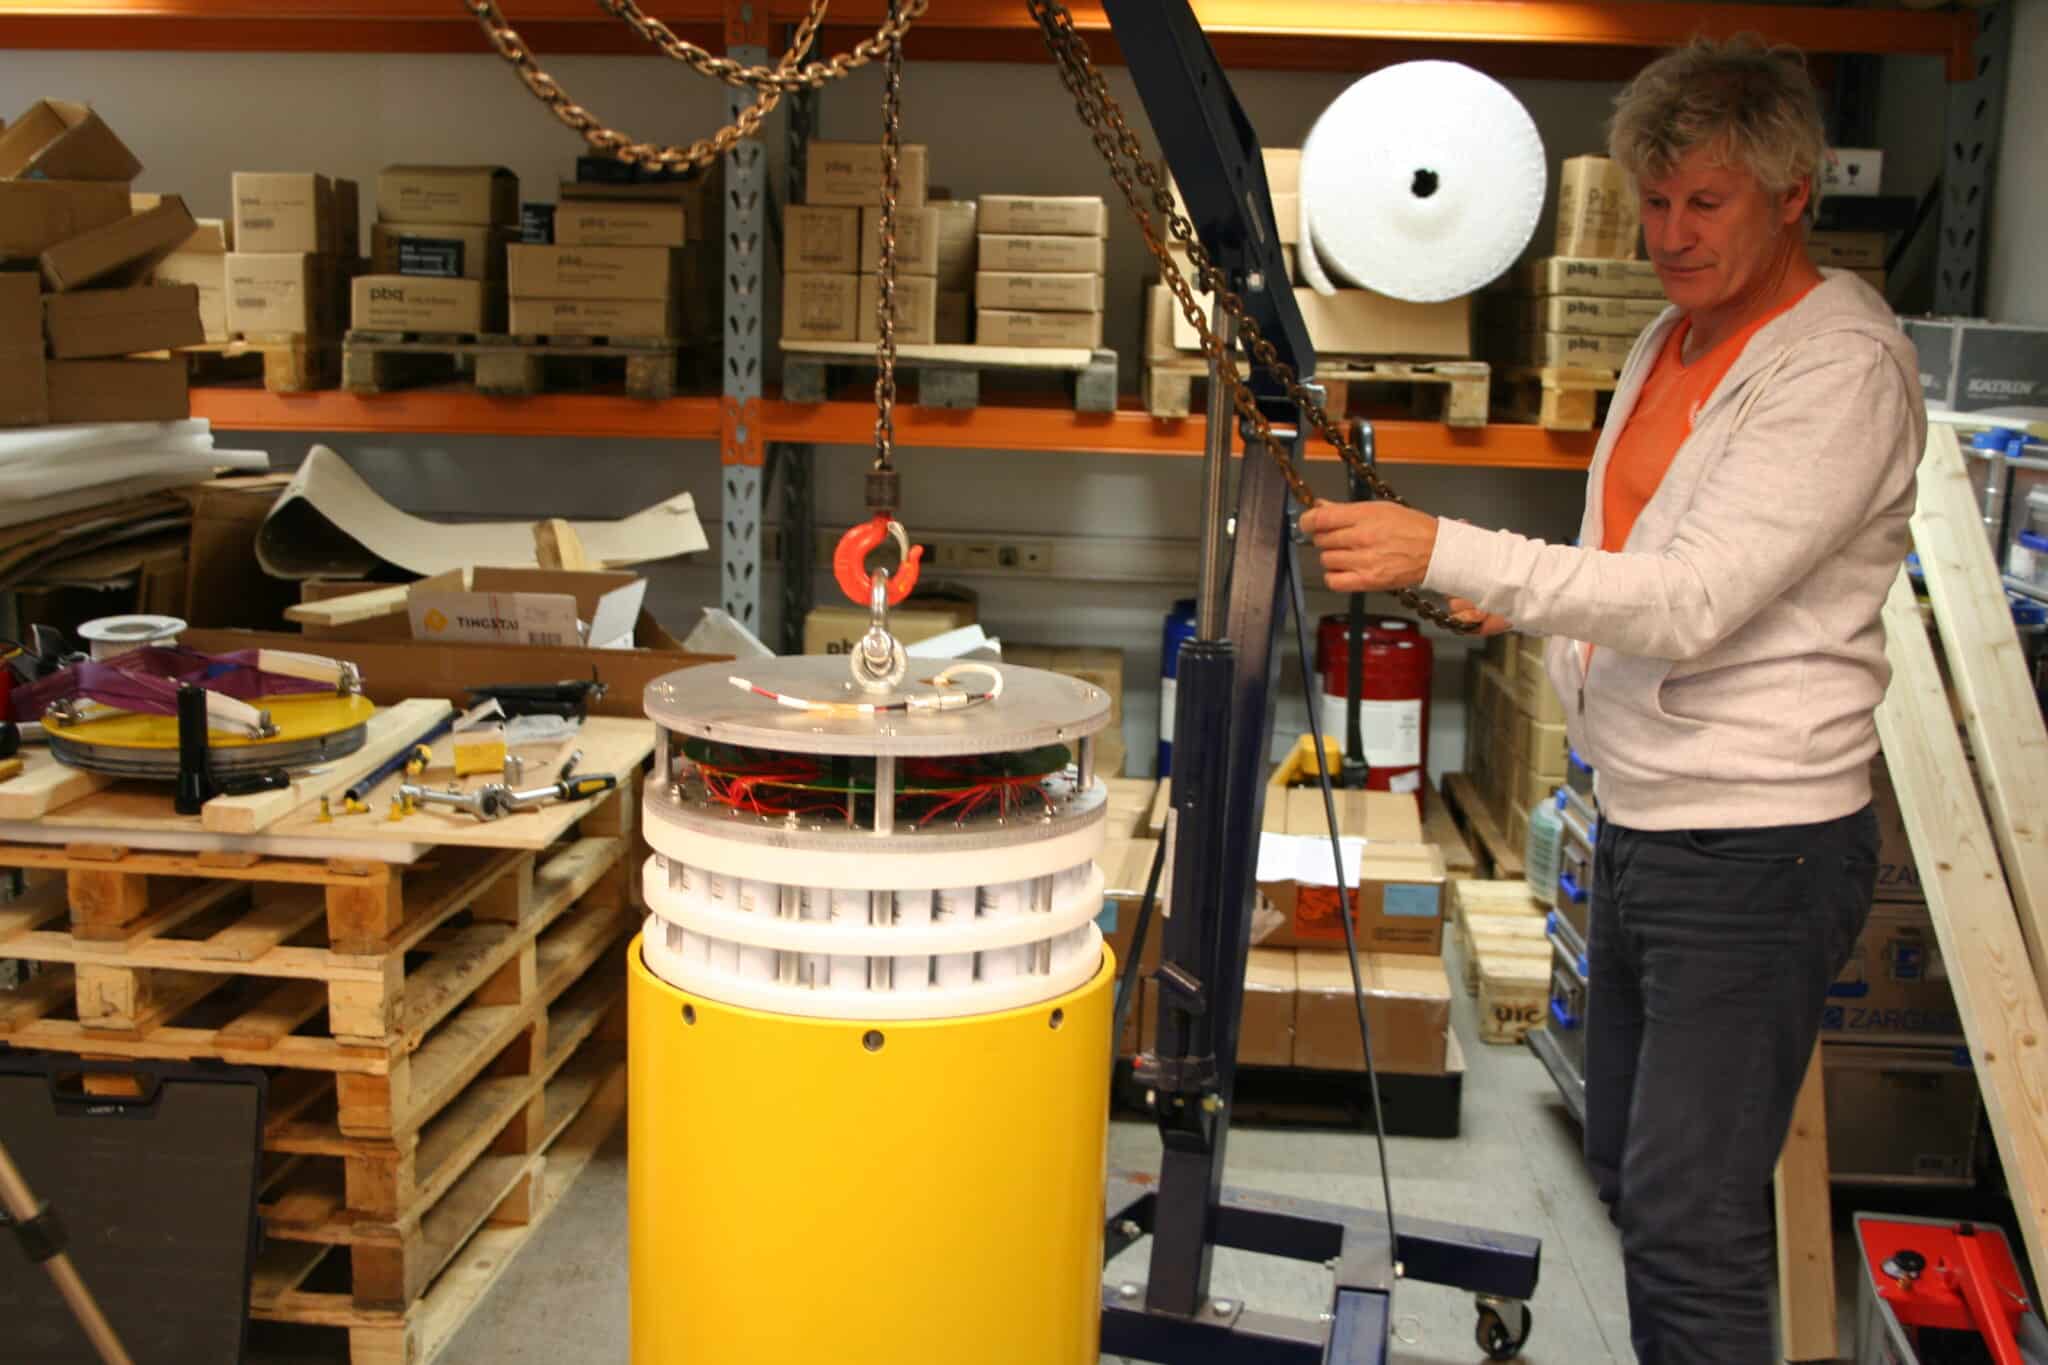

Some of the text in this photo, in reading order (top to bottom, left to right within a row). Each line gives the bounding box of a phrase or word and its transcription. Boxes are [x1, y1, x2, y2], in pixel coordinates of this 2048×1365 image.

[1567, 263, 1599, 277] pbq
[369, 287, 404, 304] pbq
[1567, 301, 1599, 315] pbq
[1567, 338, 1599, 352] pbq
[1967, 379, 2033, 394] KATRIN
[826, 638, 854, 655] pb
